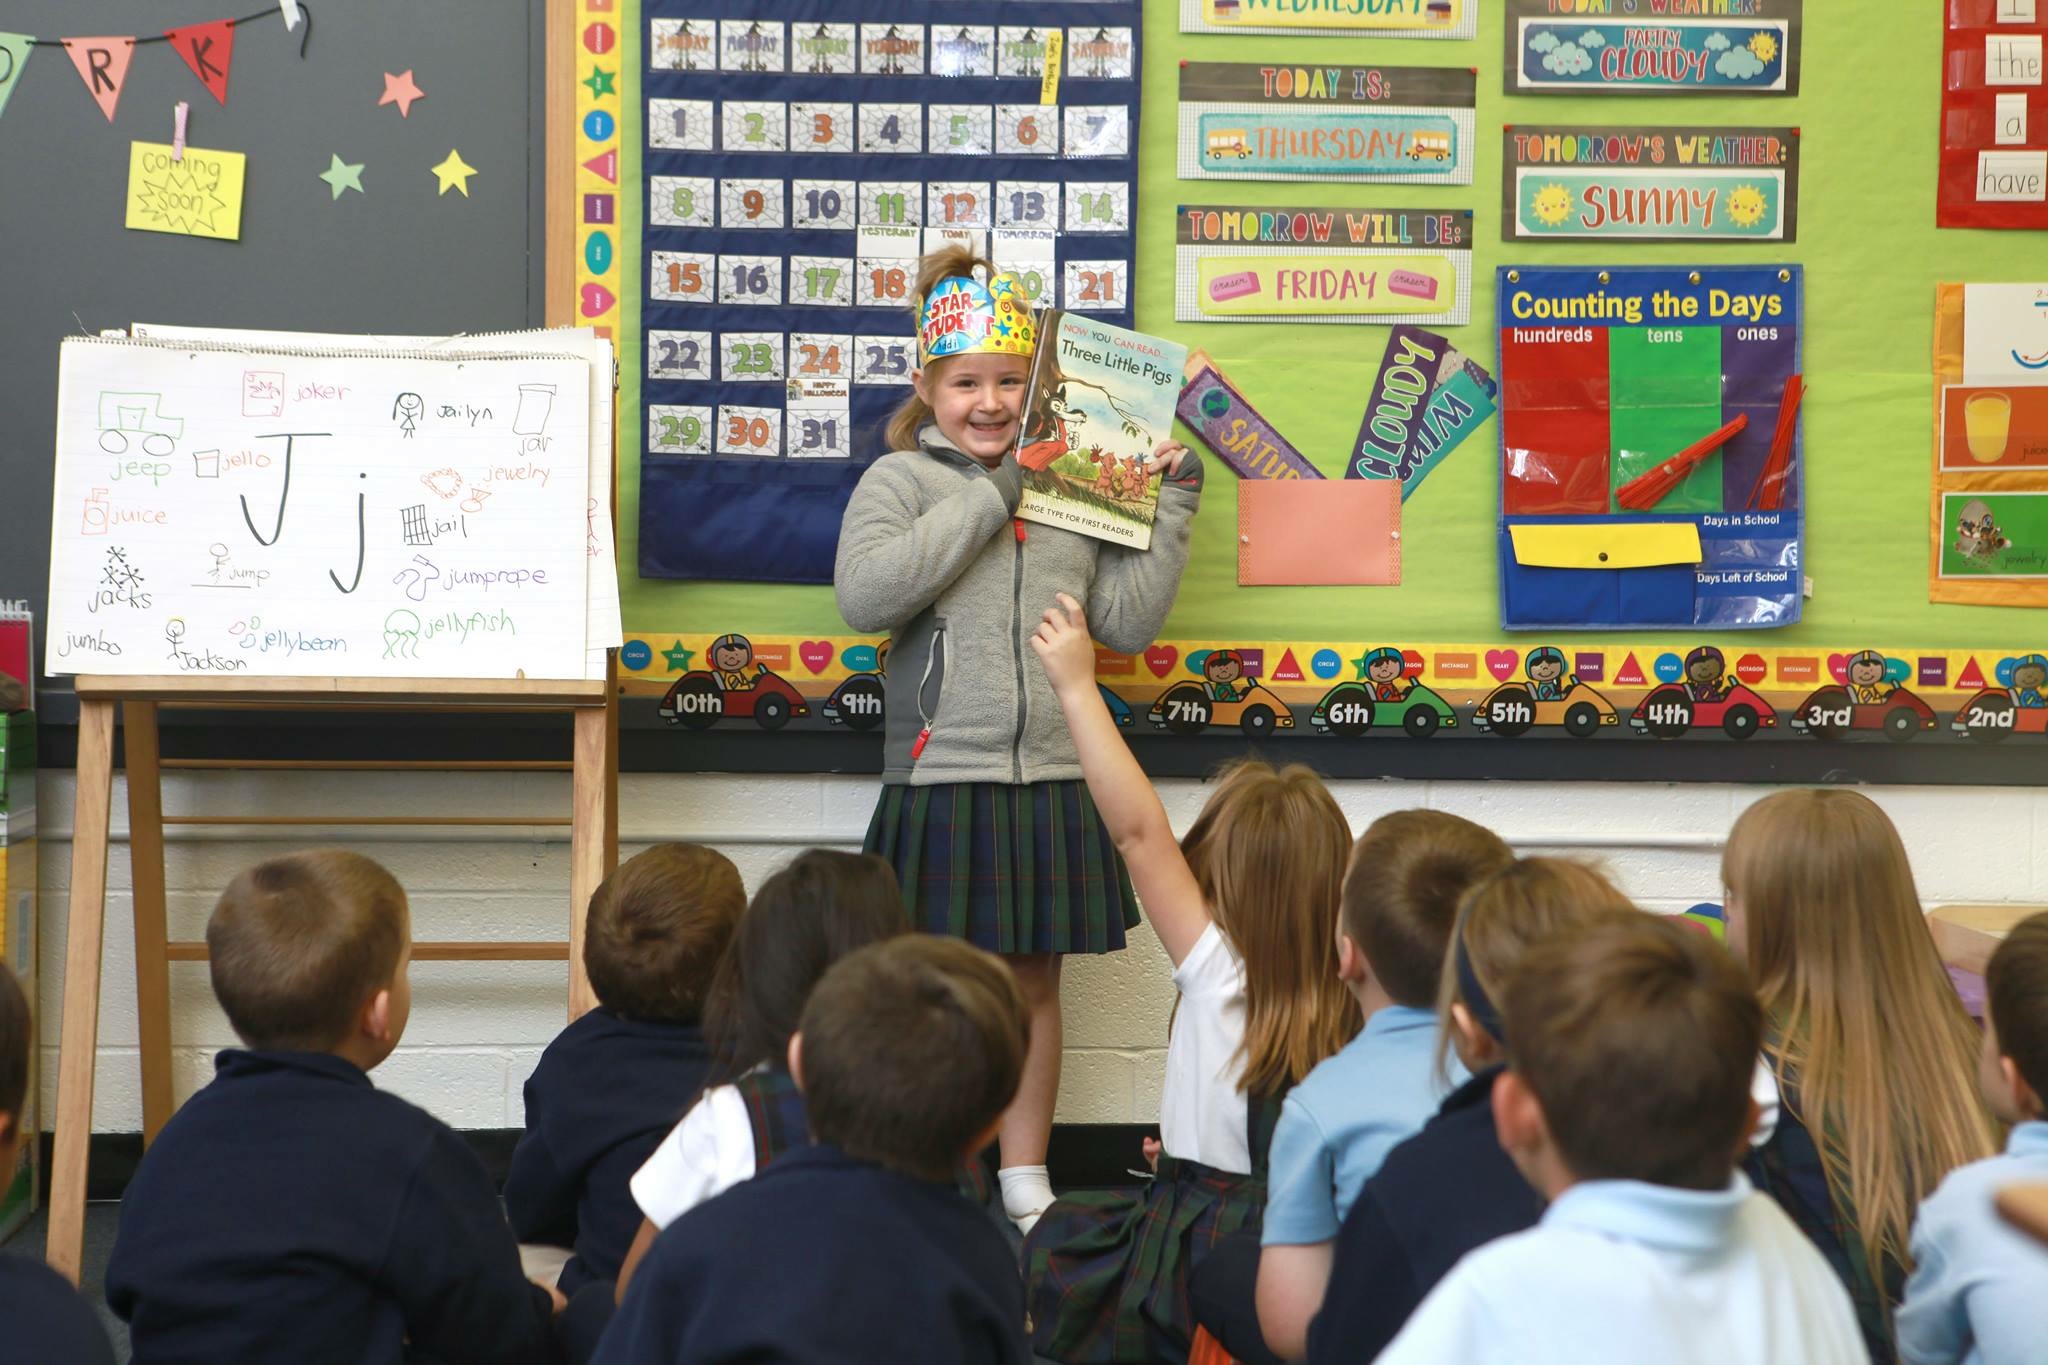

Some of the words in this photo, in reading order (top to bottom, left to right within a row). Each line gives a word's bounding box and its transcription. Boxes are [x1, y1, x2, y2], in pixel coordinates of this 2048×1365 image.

[1624, 28, 1681, 48] PARTLY
[1601, 47, 1709, 82] CLOUDY
[1994, 41, 2039, 78] the
[1261, 67, 1341, 99] TODAY
[1352, 70, 1391, 100] IS:
[672, 108, 686, 138] 1
[744, 112, 766, 142] 2
[812, 113, 833, 144] 3
[880, 115, 900, 144] 4
[950, 115, 970, 145] 5
[1017, 117, 1038, 145] 6
[2006, 116, 2022, 137] a
[1253, 125, 1405, 160] THURSDAY
[1514, 135, 1665, 164] TOMORROW'S
[1675, 136, 1787, 165] WEATHER:
[1983, 157, 2039, 194] have
[672, 187, 694, 217] 8
[743, 189, 764, 219] 9
[805, 189, 841, 219] 10
[876, 192, 905, 222] 11
[942, 192, 977, 223] 12
[1010, 191, 1045, 221] 13
[1078, 193, 1113, 223] 14
[1188, 211, 1334, 242] TOMORROW
[1346, 213, 1412, 243] WILL
[1424, 215, 1461, 244] BE:
[667, 263, 702, 293] 15
[733, 265, 768, 294] 16
[804, 267, 840, 297] 17
[871, 268, 906, 298] 18
[1078, 271, 1114, 300] 21
[1277, 269, 1377, 300] FRIDAY
[931, 292, 974, 319] STAR
[1511, 290, 1643, 323] Counting
[1651, 291, 1699, 318] the
[1709, 290, 1782, 322] Days
[923, 312, 995, 347] STUDENT
[1063, 323, 1089, 336] NOW
[1091, 331, 1111, 345] YOU
[1114, 337, 1135, 350] CAN
[1513, 327, 1593, 344] hundreds
[1647, 328, 1683, 344] tens
[1737, 327, 1778, 341] ones
[658, 340, 700, 369] 22
[731, 343, 773, 373] 23
[800, 345, 841, 374] 24
[865, 346, 907, 375] 25
[1062, 339, 1102, 364] Three
[1104, 351, 1140, 375] Little
[1143, 362, 1173, 386] Pigs
[293, 384, 351, 402] joker
[1356, 336, 1436, 480] CLOUDY
[659, 415, 700, 445] 29
[727, 416, 769, 447] 30
[802, 419, 836, 449] 31
[222, 451, 271, 471] jello
[518, 437, 552, 456] jar
[110, 460, 171, 486] jeep
[482, 463, 550, 487] jewelry
[240, 433, 333, 546] J
[110, 505, 168, 525] juice
[431, 514, 467, 538] jail
[1020, 502, 1045, 515] LARGE
[1047, 508, 1064, 520] TYPE
[1066, 512, 1081, 524] FOR
[1081, 518, 1101, 530] FIRST
[1102, 522, 1134, 538] READERS
[1704, 515, 1729, 528] Days
[1732, 515, 1742, 525] in
[1744, 514, 1780, 526] School
[329, 473, 366, 594] j
[229, 567, 270, 587] jump
[443, 569, 550, 592] jumprope
[1697, 572, 1720, 585] Days
[1723, 572, 1741, 583] Left
[1743, 572, 1753, 583] of
[1755, 571, 1788, 583] School
[88, 586, 152, 613] jacks
[424, 608, 515, 644] jellyfish
[58, 629, 122, 657] jumbo
[260, 629, 347, 656] jellybean
[178, 648, 247, 672] Jackson
[676, 693, 722, 713] 10th
[842, 693, 881, 714] 9th
[1167, 701, 1206, 723] 7th
[1329, 703, 1369, 724] 6th
[1492, 703, 1530, 724] 5th
[1648, 705, 1689, 725] 4th
[1808, 706, 1851, 727] 3rd
[1968, 707, 2014, 728] 2nd
